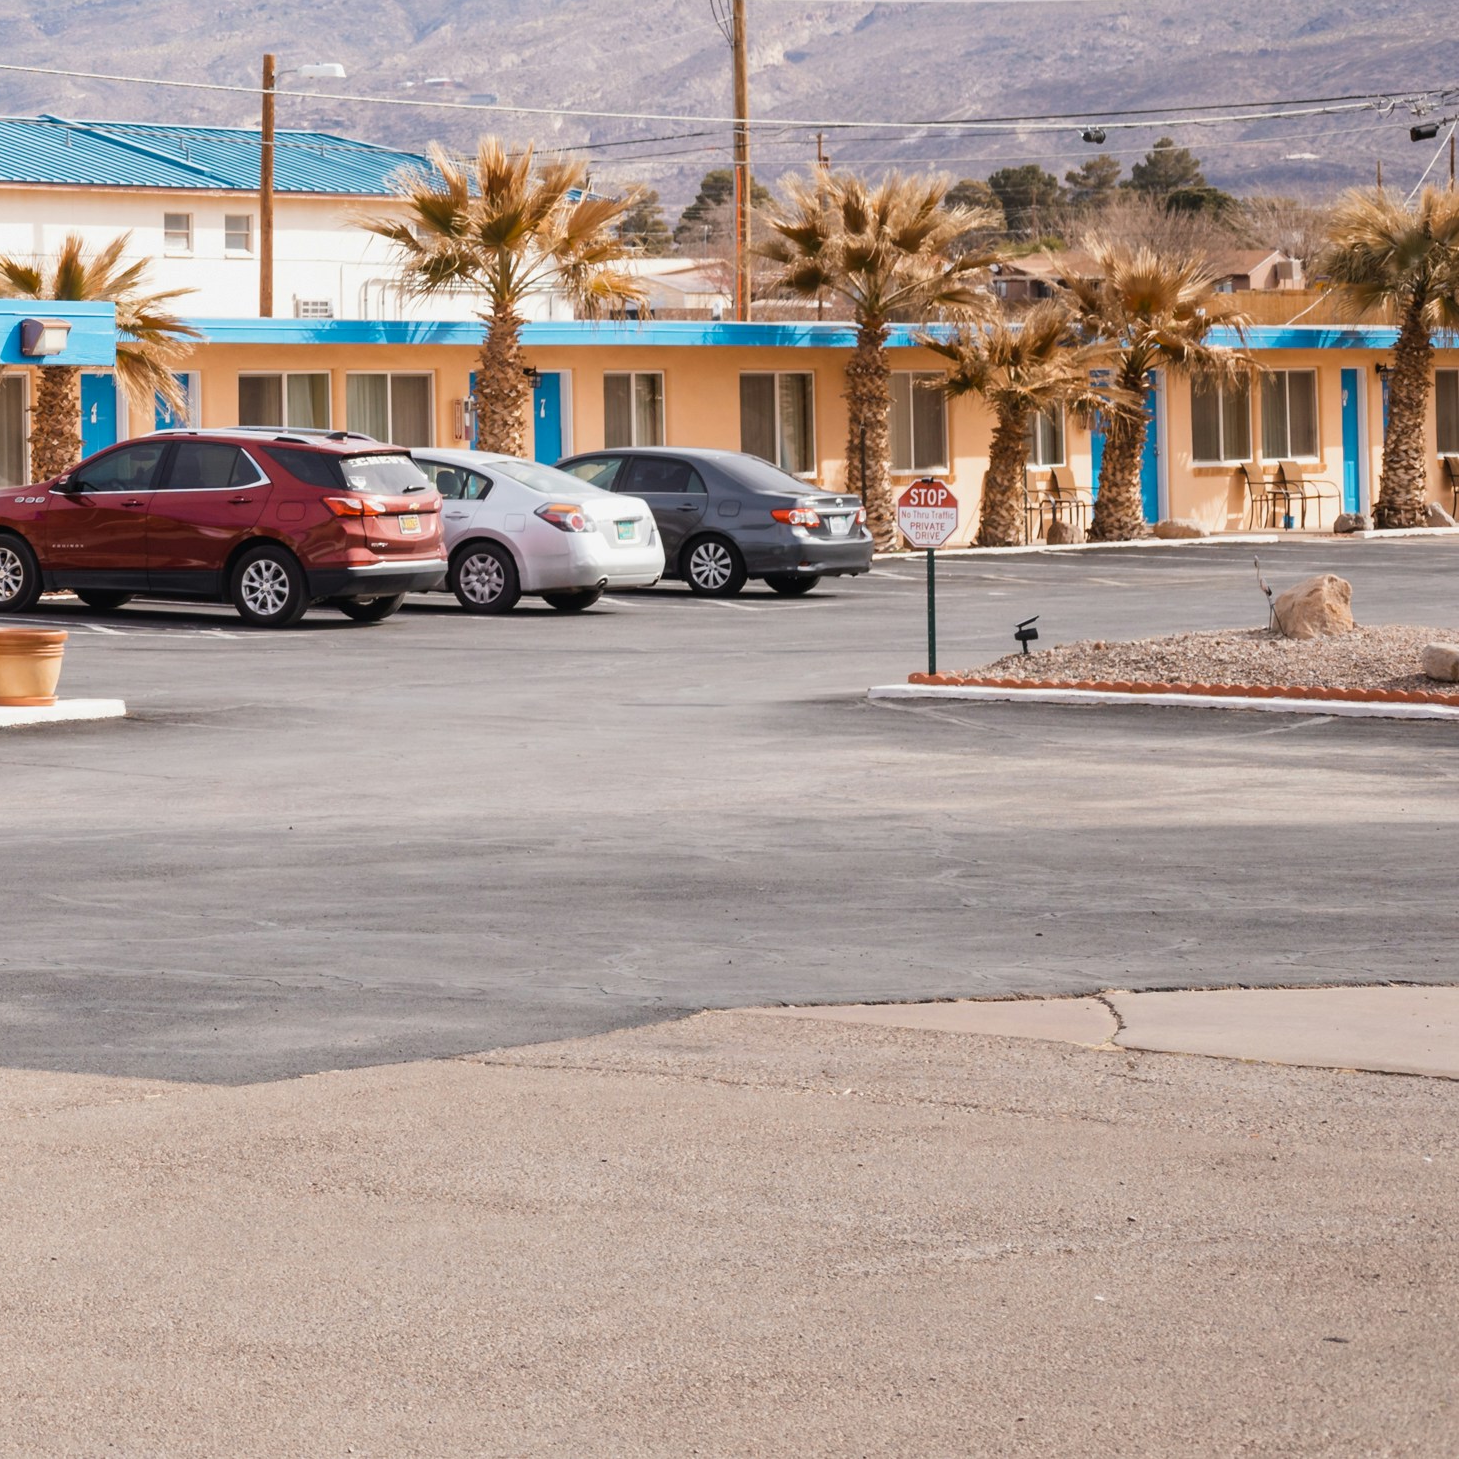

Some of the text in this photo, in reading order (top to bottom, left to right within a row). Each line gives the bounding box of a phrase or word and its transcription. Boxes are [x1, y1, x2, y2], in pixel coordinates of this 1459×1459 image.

[909, 488, 947, 506] STOP
[901, 509, 954, 520] No Thru Traffic
[910, 522, 946, 531] PRIVATE
[915, 531, 941, 541] DRIVE
